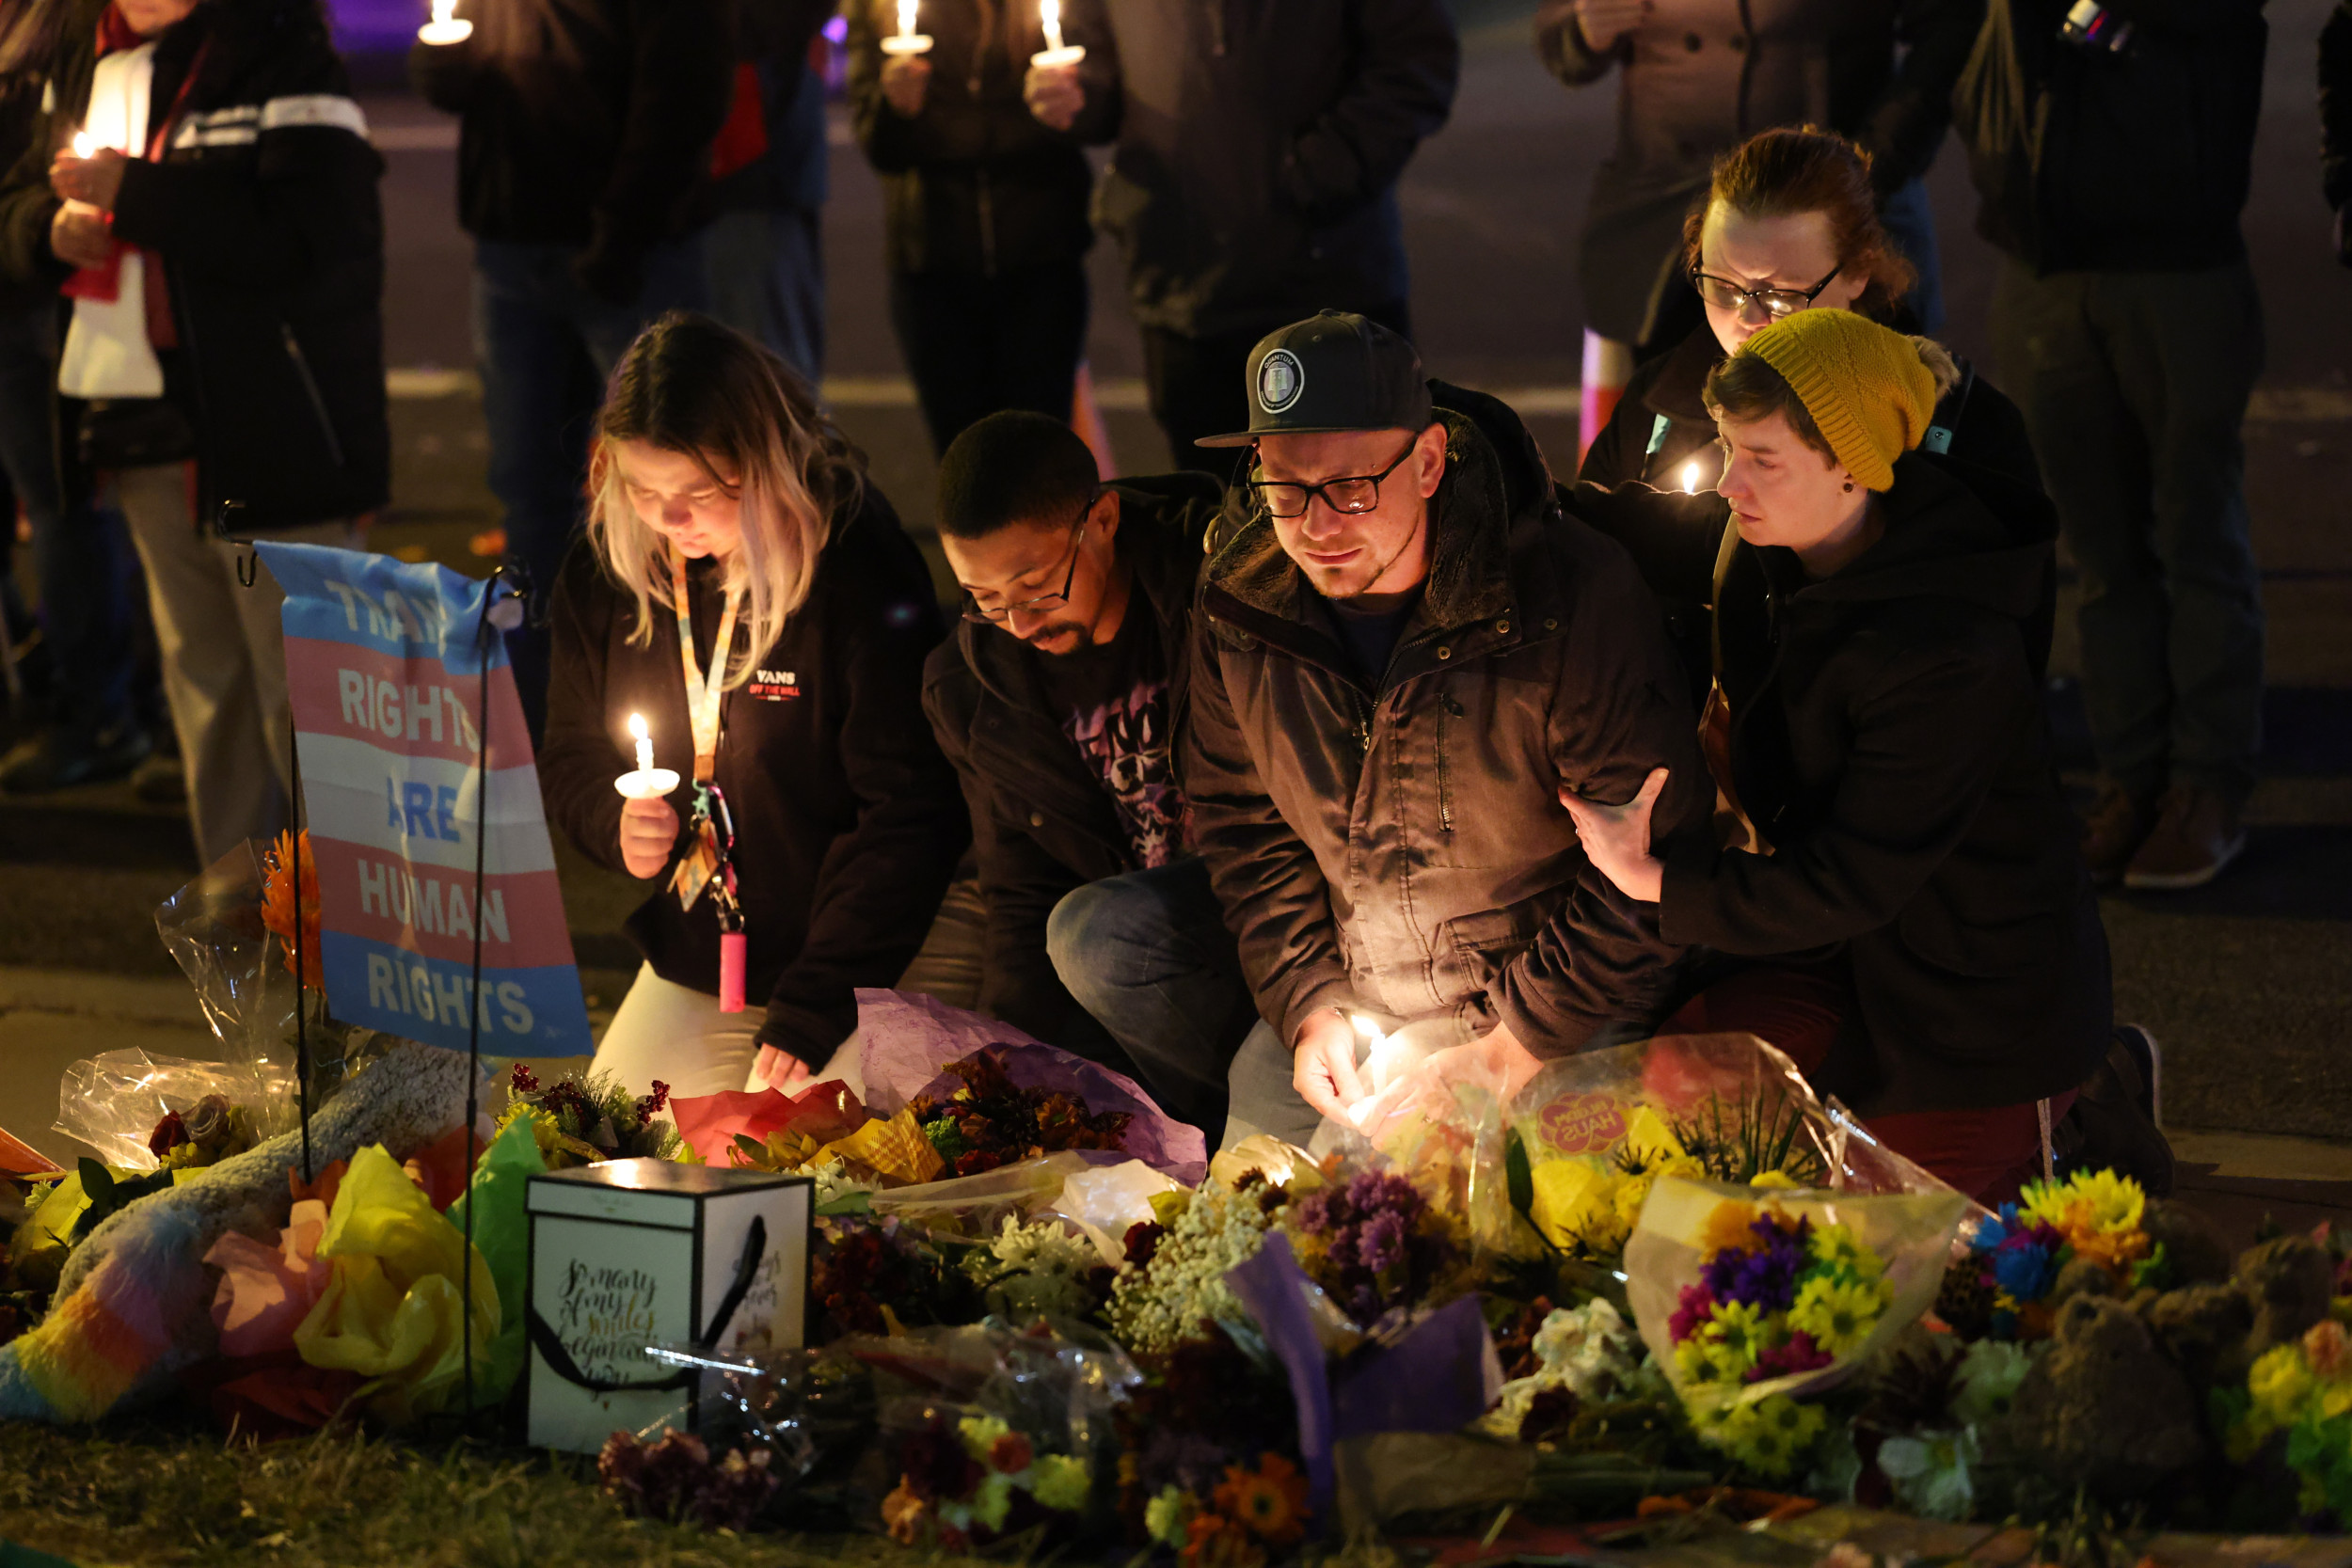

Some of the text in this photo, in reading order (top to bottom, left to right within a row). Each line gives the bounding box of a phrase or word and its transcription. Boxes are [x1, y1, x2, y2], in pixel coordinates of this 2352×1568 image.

[1263, 354, 1295, 369] QUANTUM
[756, 670, 796, 685] VANS
[386, 776, 461, 844] ARE
[358, 859, 511, 943] HUMAN
[368, 953, 533, 1035] RIGHTS
[590, 1267, 656, 1308] many
